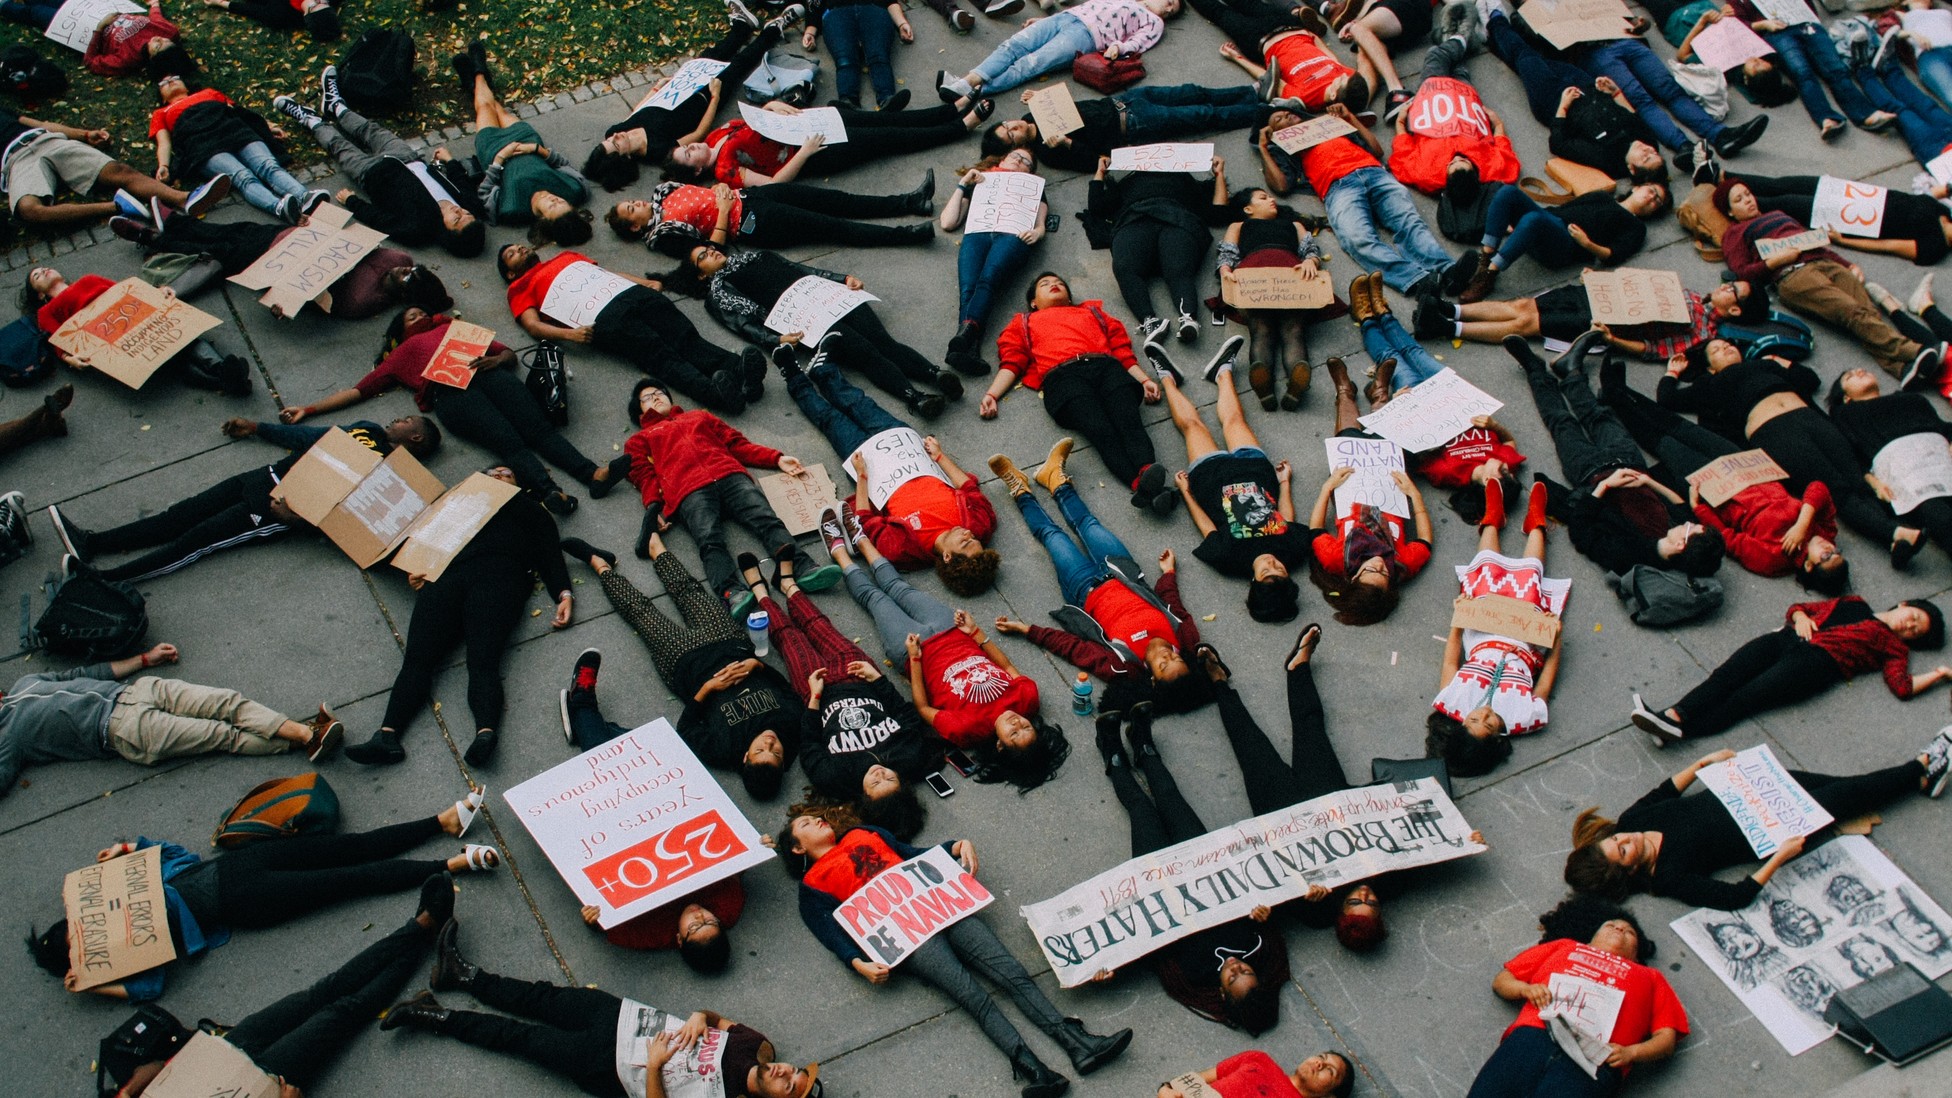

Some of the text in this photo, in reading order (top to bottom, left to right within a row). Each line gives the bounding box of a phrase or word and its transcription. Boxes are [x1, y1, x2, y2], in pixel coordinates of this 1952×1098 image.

[51, 0, 93, 45] ESIST
[1414, 93, 1488, 136] STOP
[1134, 145, 1175, 161] 523
[265, 229, 327, 272] KILLS
[287, 238, 363, 292] RACISM
[783, 302, 798, 324] DAY
[828, 294, 861, 318] LIES
[121, 311, 169, 352] OCCUPYING
[128, 317, 182, 358] INDIGENOUS
[141, 329, 183, 362] LAND
[1336, 440, 1397, 455] LAND
[1338, 455, 1404, 468] NATIVE
[876, 462, 920, 501] MORE
[1354, 489, 1403, 514] YOU
[721, 688, 781, 726] NIKE
[821, 697, 886, 727] UNIVERSITY
[586, 735, 644, 770] Land
[827, 717, 901, 755] BROWN
[528, 750, 664, 818] Indigenous
[580, 766, 685, 819] occupying
[1737, 763, 1814, 835] RESIST
[580, 784, 705, 860] Years of
[1263, 816, 1308, 845] speech
[1314, 806, 1347, 828] hate
[596, 822, 732, 894] 250+
[1142, 859, 1184, 881] since
[125, 852, 157, 947] INTERNAL ERRORS
[839, 859, 944, 938] PROUD TO
[1043, 815, 1455, 968] THE BROWN DAILY HATERS
[866, 872, 990, 966] BE NAVAJO
[81, 912, 112, 972] ERASURE
[1554, 983, 1605, 1025] WE
